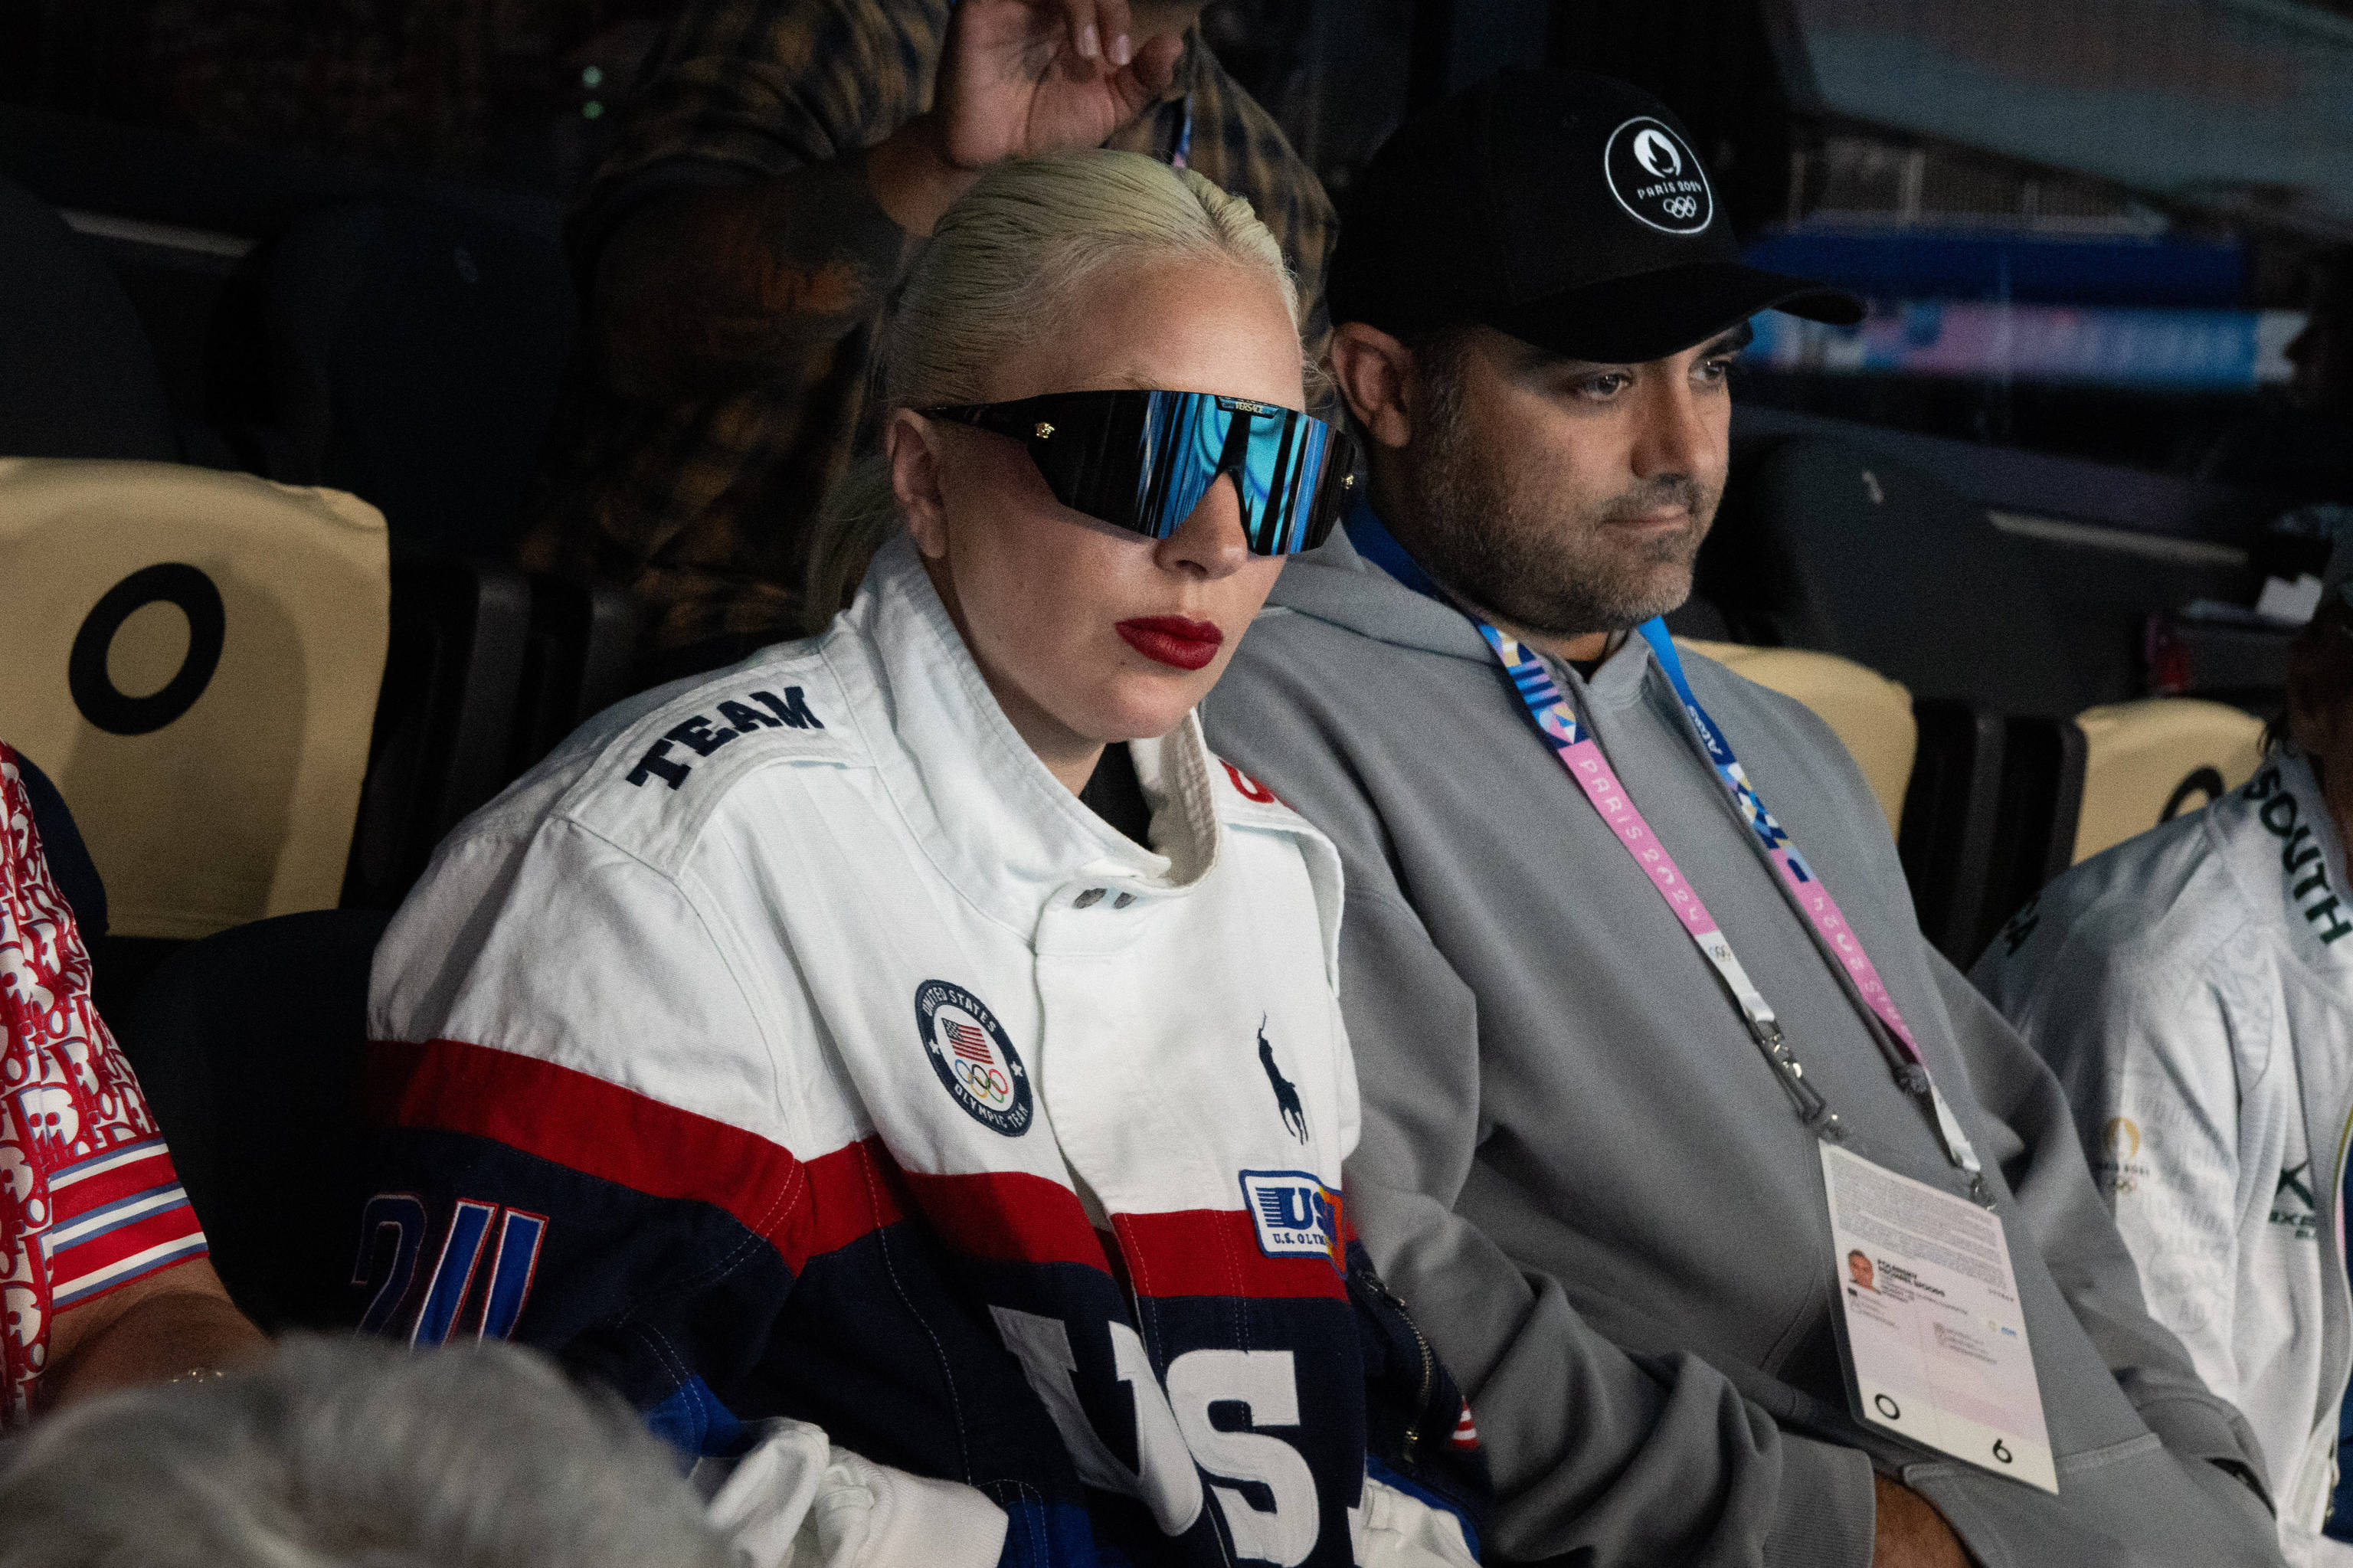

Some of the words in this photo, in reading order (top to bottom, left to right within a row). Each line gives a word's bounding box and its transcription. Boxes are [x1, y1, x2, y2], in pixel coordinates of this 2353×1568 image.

[1637, 181, 1677, 200] PARIS
[625, 686, 825, 791] TEAM
[1579, 759, 1644, 840] PARIS
[2243, 768, 2353, 944] SOUTH
[922, 987, 948, 1017] UNITED
[948, 990, 997, 1033] STATES
[954, 1082, 1008, 1129] OLYMPIC
[1008, 1102, 1029, 1129] TEAM
[1272, 1232, 1295, 1245] U.S.
[1991, 1439, 2013, 1464] 6
